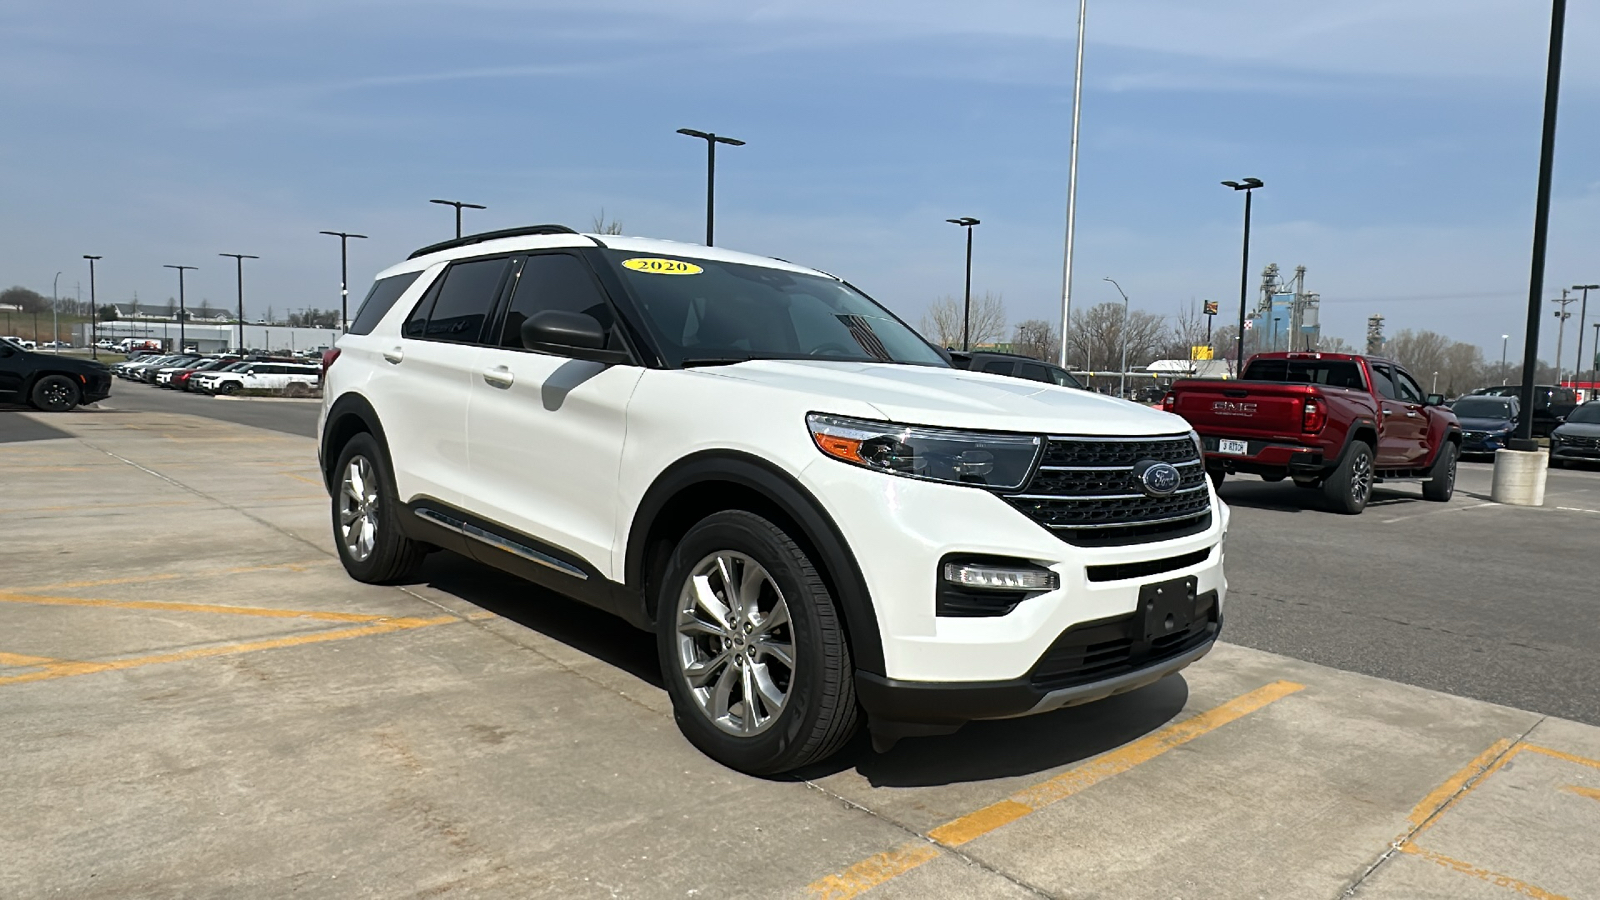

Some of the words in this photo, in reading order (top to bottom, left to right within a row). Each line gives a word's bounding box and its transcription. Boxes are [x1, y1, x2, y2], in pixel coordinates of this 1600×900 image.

[638, 261, 687, 271] 2020
[1212, 401, 1257, 412] GMC
[1154, 469, 1175, 487] Ford
